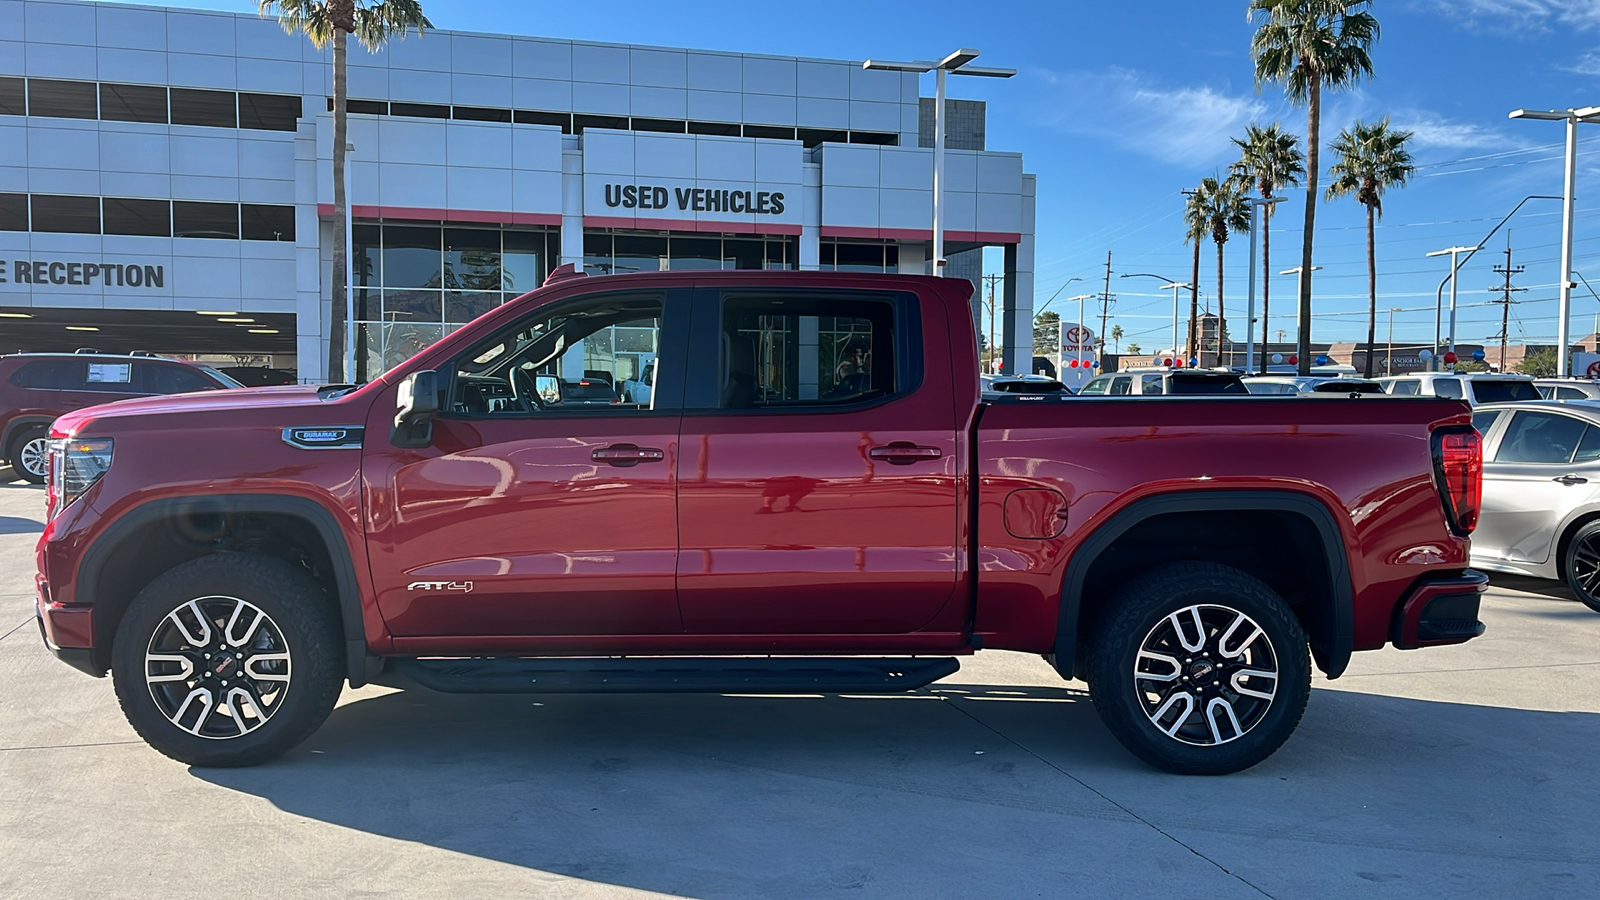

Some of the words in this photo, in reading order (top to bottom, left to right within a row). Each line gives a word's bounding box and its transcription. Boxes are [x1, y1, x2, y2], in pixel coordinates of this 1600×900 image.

[605, 184, 668, 209] USED
[675, 188, 785, 214] VEHICLES
[14, 260, 164, 288] RECEPTION
[1063, 344, 1093, 352] TOYTA
[407, 581, 474, 593] AT4
[215, 656, 232, 673] GMC
